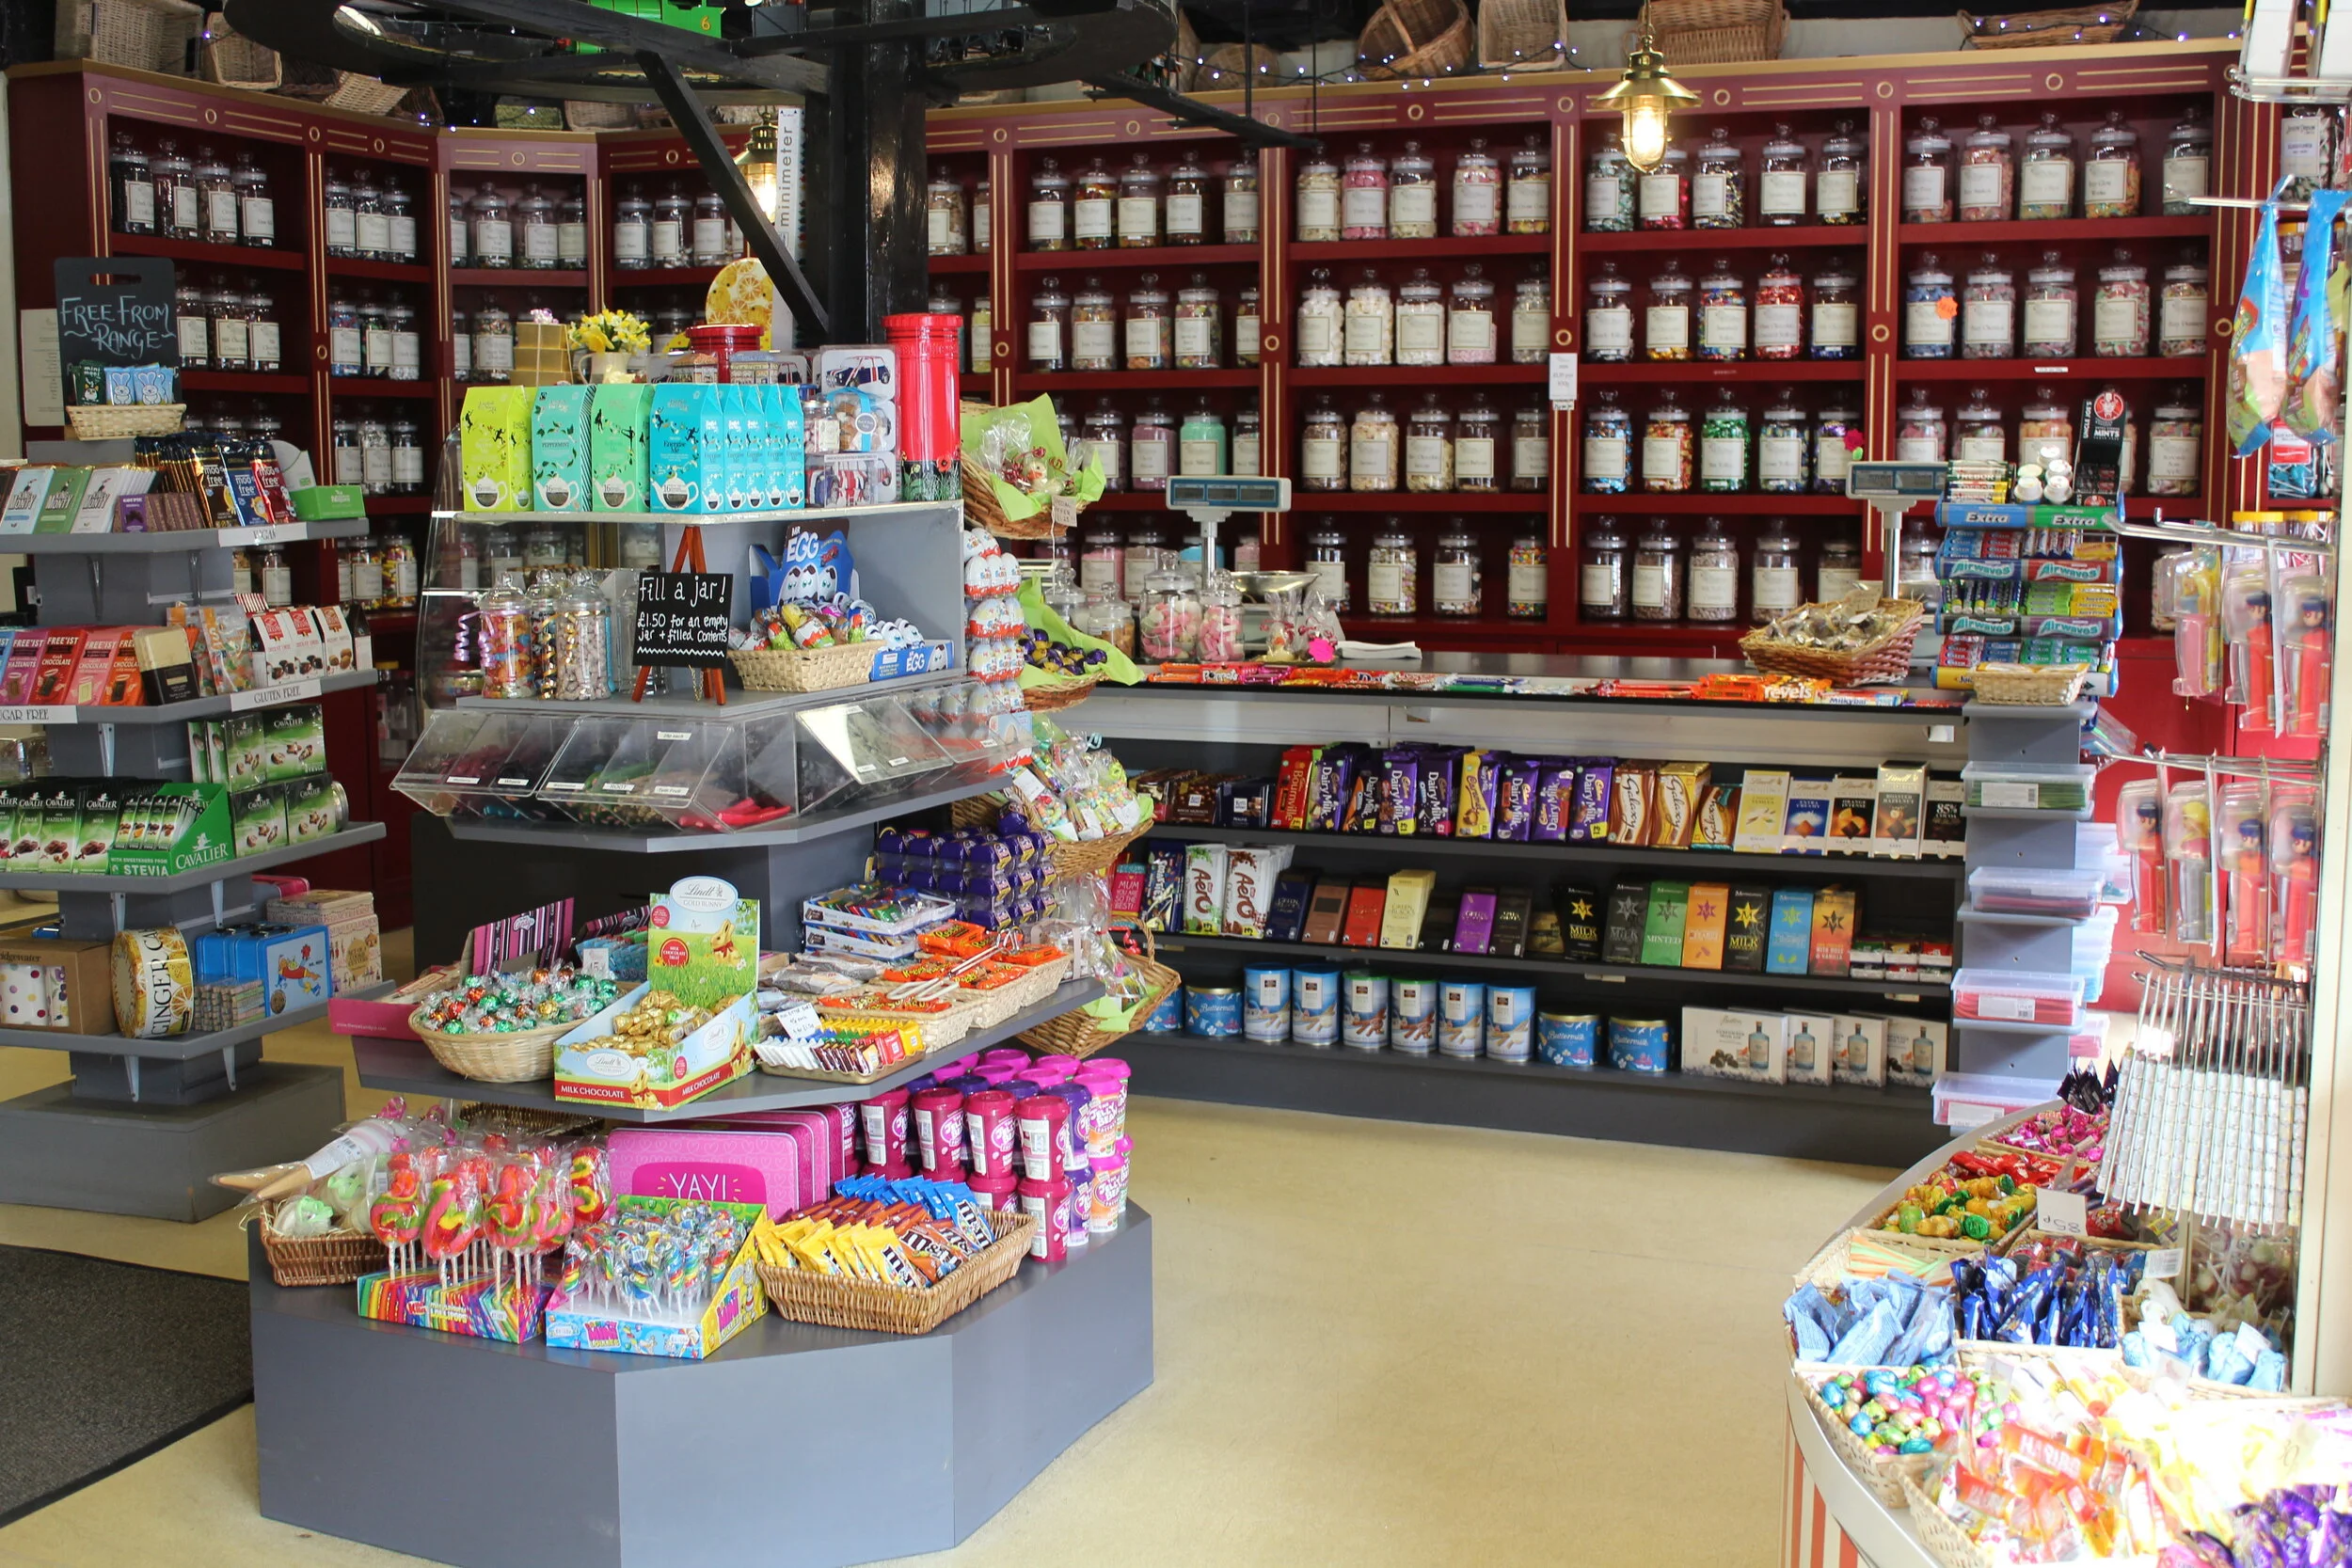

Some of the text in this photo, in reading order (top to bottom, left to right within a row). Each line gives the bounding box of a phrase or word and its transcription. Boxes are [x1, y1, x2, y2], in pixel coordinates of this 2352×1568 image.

[701, 16, 711, 30] 6
[779, 126, 794, 228] minimeter
[91, 322, 164, 359] RANGE
[1965, 511, 2010, 523] Extra
[2053, 515, 2097, 527] Extra
[787, 531, 819, 562] EGG
[1952, 561, 2015, 578] Airwaves
[2038, 562, 2102, 581] Airwaves
[640, 577, 666, 601] Fill
[675, 581, 685, 601] a
[637, 611, 728, 632] £1.50 for an empty
[1952, 617, 2015, 634] Airwaves
[2039, 618, 2103, 637] Airwaves
[47, 636, 79, 645] FREE'IST
[638, 627, 655, 641] jar
[667, 628, 693, 644] filled
[906, 655, 925, 673] EGG
[254, 685, 301, 704] GLUTEN FREE
[1764, 684, 1811, 700] revels
[26, 708, 49, 721] FREE
[274, 717, 303, 729] CAVALIER
[45, 798, 75, 807] CAVALIER
[1285, 769, 1304, 821] Bournville
[1390, 769, 1404, 822] Dairy Milk
[1427, 771, 1443, 826] Dairy Milk
[1582, 769, 1597, 825] Dairy Milk
[1622, 774, 1636, 831] Galaxy
[1667, 774, 1682, 829] Galaxy
[87, 800, 117, 809] CAVALIER
[1510, 777, 1529, 831] Dairy Milk
[1541, 779, 1561, 832] Dairy Milk
[1937, 803, 1958, 814] 85%
[176, 843, 229, 870] CAVALIER
[124, 864, 169, 877] STEVIA
[685, 882, 715, 897] Lindt
[1192, 867, 1214, 914] Aero
[1234, 872, 1256, 919] Aero
[1569, 926, 1597, 936] MILK
[1646, 935, 1682, 944] MINTED
[1730, 937, 1759, 947] MILK
[148, 951, 172, 1036] GINGER
[1548, 1031, 1584, 1042] Buttermilk
[1613, 1035, 1649, 1047] Buttermilk
[681, 1070, 721, 1096] MILK CHOCOLATE
[561, 1085, 625, 1099] MILK CHOCOLATE
[1089, 1102, 1117, 1119] JELLY
[1099, 1178, 1120, 1194] JELLY
[430, 1308, 468, 1323] LOLLIPOPS
